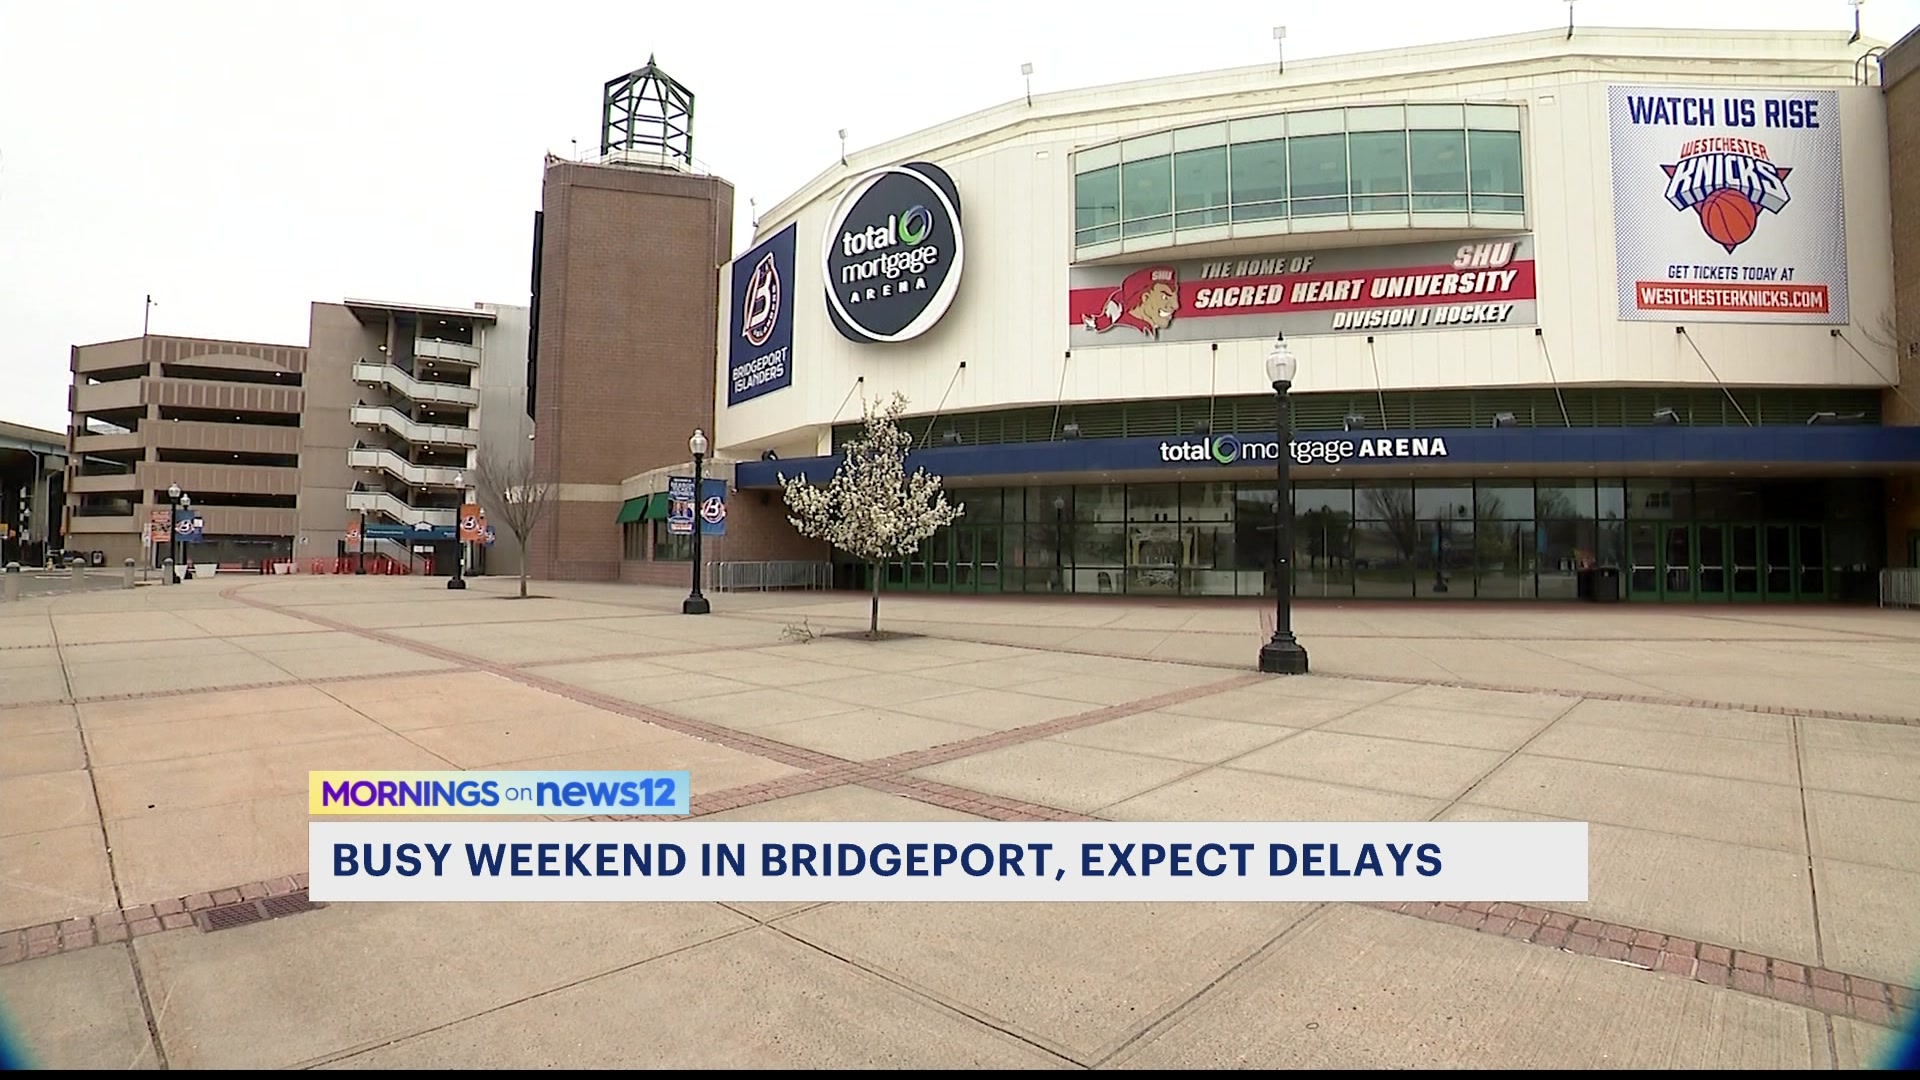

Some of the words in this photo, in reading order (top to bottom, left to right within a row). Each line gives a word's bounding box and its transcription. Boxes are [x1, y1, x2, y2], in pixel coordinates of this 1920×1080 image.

[1627, 96, 1715, 126] WATCH
[1724, 98, 1756, 127] US
[1765, 99, 1820, 128] RISE
[1680, 137, 1770, 161] WESTCHESTER
[1665, 152, 1791, 213] KNICKS
[842, 214, 897, 256] total
[842, 245, 938, 284] mortgage
[1201, 262, 1232, 279] THE
[1235, 257, 1286, 277] HOME
[1289, 256, 1314, 273] OF
[1452, 242, 1517, 270] SHU
[1151, 270, 1173, 281] SHU
[1668, 265, 1690, 279] GET
[1693, 266, 1738, 280] TICKETS
[1742, 267, 1778, 281] TODAY
[1780, 268, 1795, 281] AT
[850, 277, 927, 303] ARENA
[1195, 284, 1285, 309] SACRED
[1291, 279, 1365, 304] HEART
[1370, 270, 1517, 299] UNIVERSITY
[1641, 287, 1823, 308] WESTCHESTERKNICKS.COM
[1332, 308, 1416, 329] DIVISION
[1420, 308, 1431, 325] I
[1435, 304, 1513, 325] HOCKEY
[732, 347, 788, 381] BRIDGEPORT
[734, 363, 784, 393] ISLANDERS
[1160, 437, 1211, 461] total
[1242, 439, 1354, 463] motgage
[1358, 438, 1447, 457] ARENA
